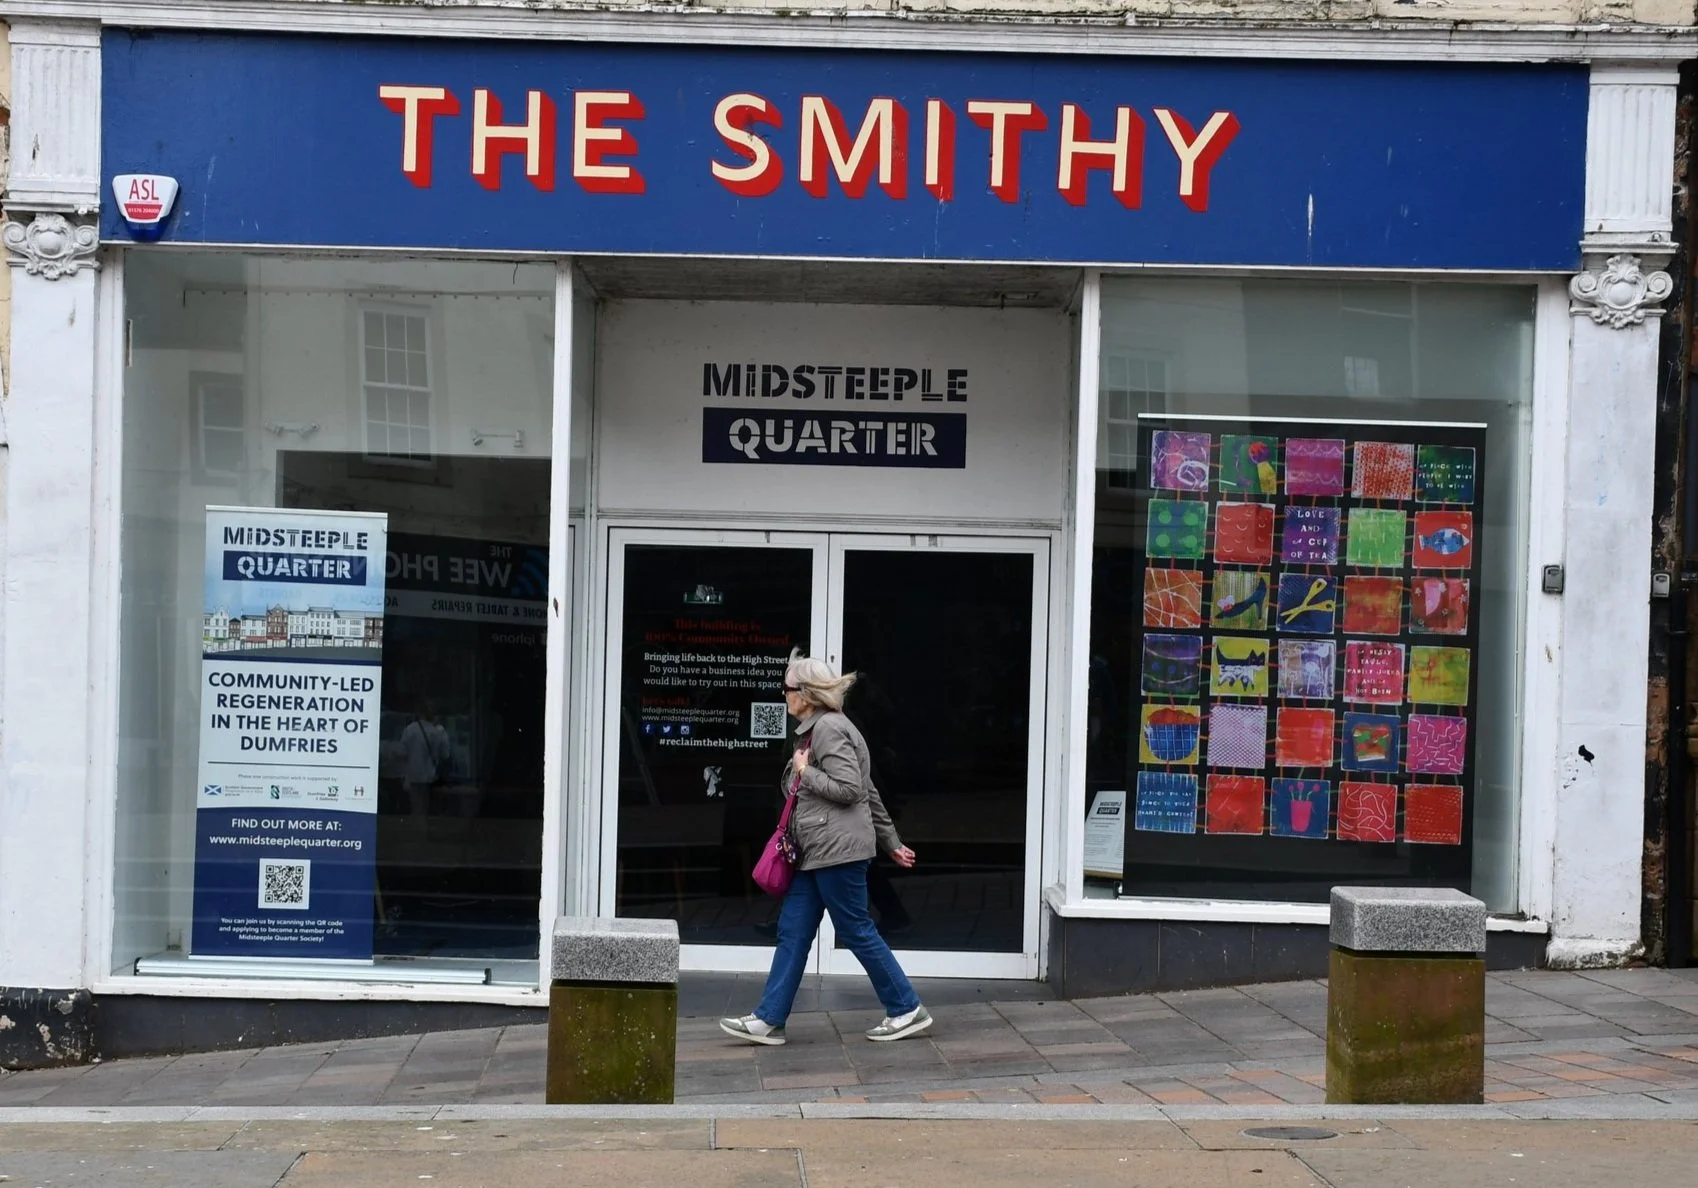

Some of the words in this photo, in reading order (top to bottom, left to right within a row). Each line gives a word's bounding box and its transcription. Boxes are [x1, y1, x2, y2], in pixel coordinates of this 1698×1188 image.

[379, 85, 646, 194] THE
[711, 92, 1240, 212] SMITHY
[128, 178, 160, 201] ASL
[702, 362, 968, 402] MIDSTEEPLE
[728, 417, 938, 460] QUARTER
[1297, 510, 1325, 518] LOVE
[1300, 524, 1320, 532] AND
[223, 526, 368, 550] MIDSTEEPLE
[1308, 538, 1328, 546] CUP
[1310, 551, 1327, 560] TEA
[237, 555, 352, 579] QUARTER
[644, 652, 680, 664] Bringing
[681, 653, 696, 662] life
[697, 653, 716, 662] back
[718, 654, 726, 663] to
[727, 654, 740, 663] the
[742, 656, 760, 666] High
[650, 664, 660, 673] Do
[662, 667, 678, 676] you
[680, 665, 700, 674] have
[708, 666, 745, 676] business
[747, 666, 764, 676] idea
[766, 670, 782, 678] you
[208, 672, 374, 693] COMMUNITY-LED
[643, 677, 669, 686] would
[671, 677, 687, 686] like
[688, 678, 697, 686] to
[698, 679, 712, 688] try
[730, 678, 738, 688] in
[740, 679, 756, 688] this
[758, 681, 782, 690] space
[216, 693, 365, 713] REGENERATION
[642, 706, 740, 718] info@midsteeplequarter.org
[211, 714, 230, 729] IN
[236, 714, 271, 731] THE
[277, 716, 338, 733] HEART
[343, 719, 369, 734] OF
[642, 715, 740, 725] www.midsteeplequarter.org
[240, 736, 338, 754] DUMFRIES
[659, 737, 768, 750] #reclaimthehighstreet
[232, 818, 258, 829] FIND
[261, 819, 286, 830] OUT
[288, 820, 322, 831] MORE
[325, 821, 342, 831] AT:
[209, 835, 362, 850] www.midsteeplequarter.org
[268, 918, 276, 926] by
[232, 926, 259, 934] applying
[239, 934, 273, 942] Midsteeple
